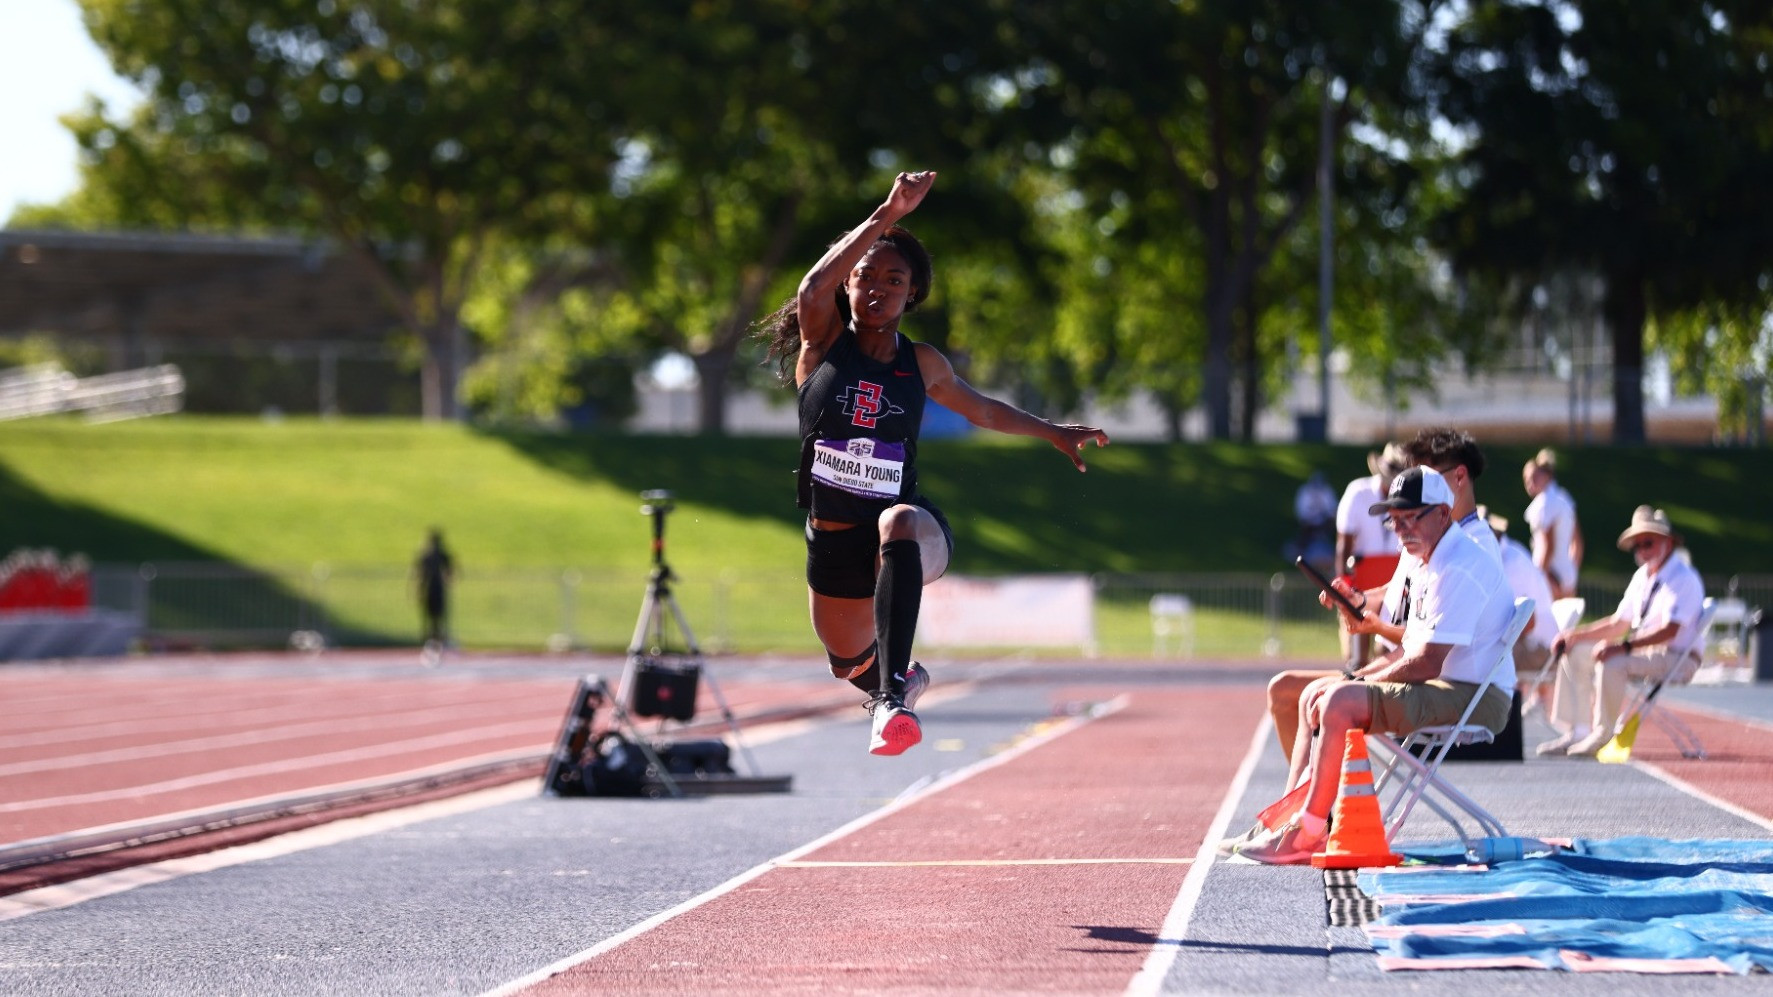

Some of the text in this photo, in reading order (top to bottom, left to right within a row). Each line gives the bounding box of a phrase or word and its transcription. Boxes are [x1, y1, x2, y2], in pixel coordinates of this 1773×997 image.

[816, 449, 900, 483] XIAMARA YOUNG
[833, 474, 842, 483] SAN
[842, 477, 858, 486] DIEGO
[858, 480, 874, 489] STATE
